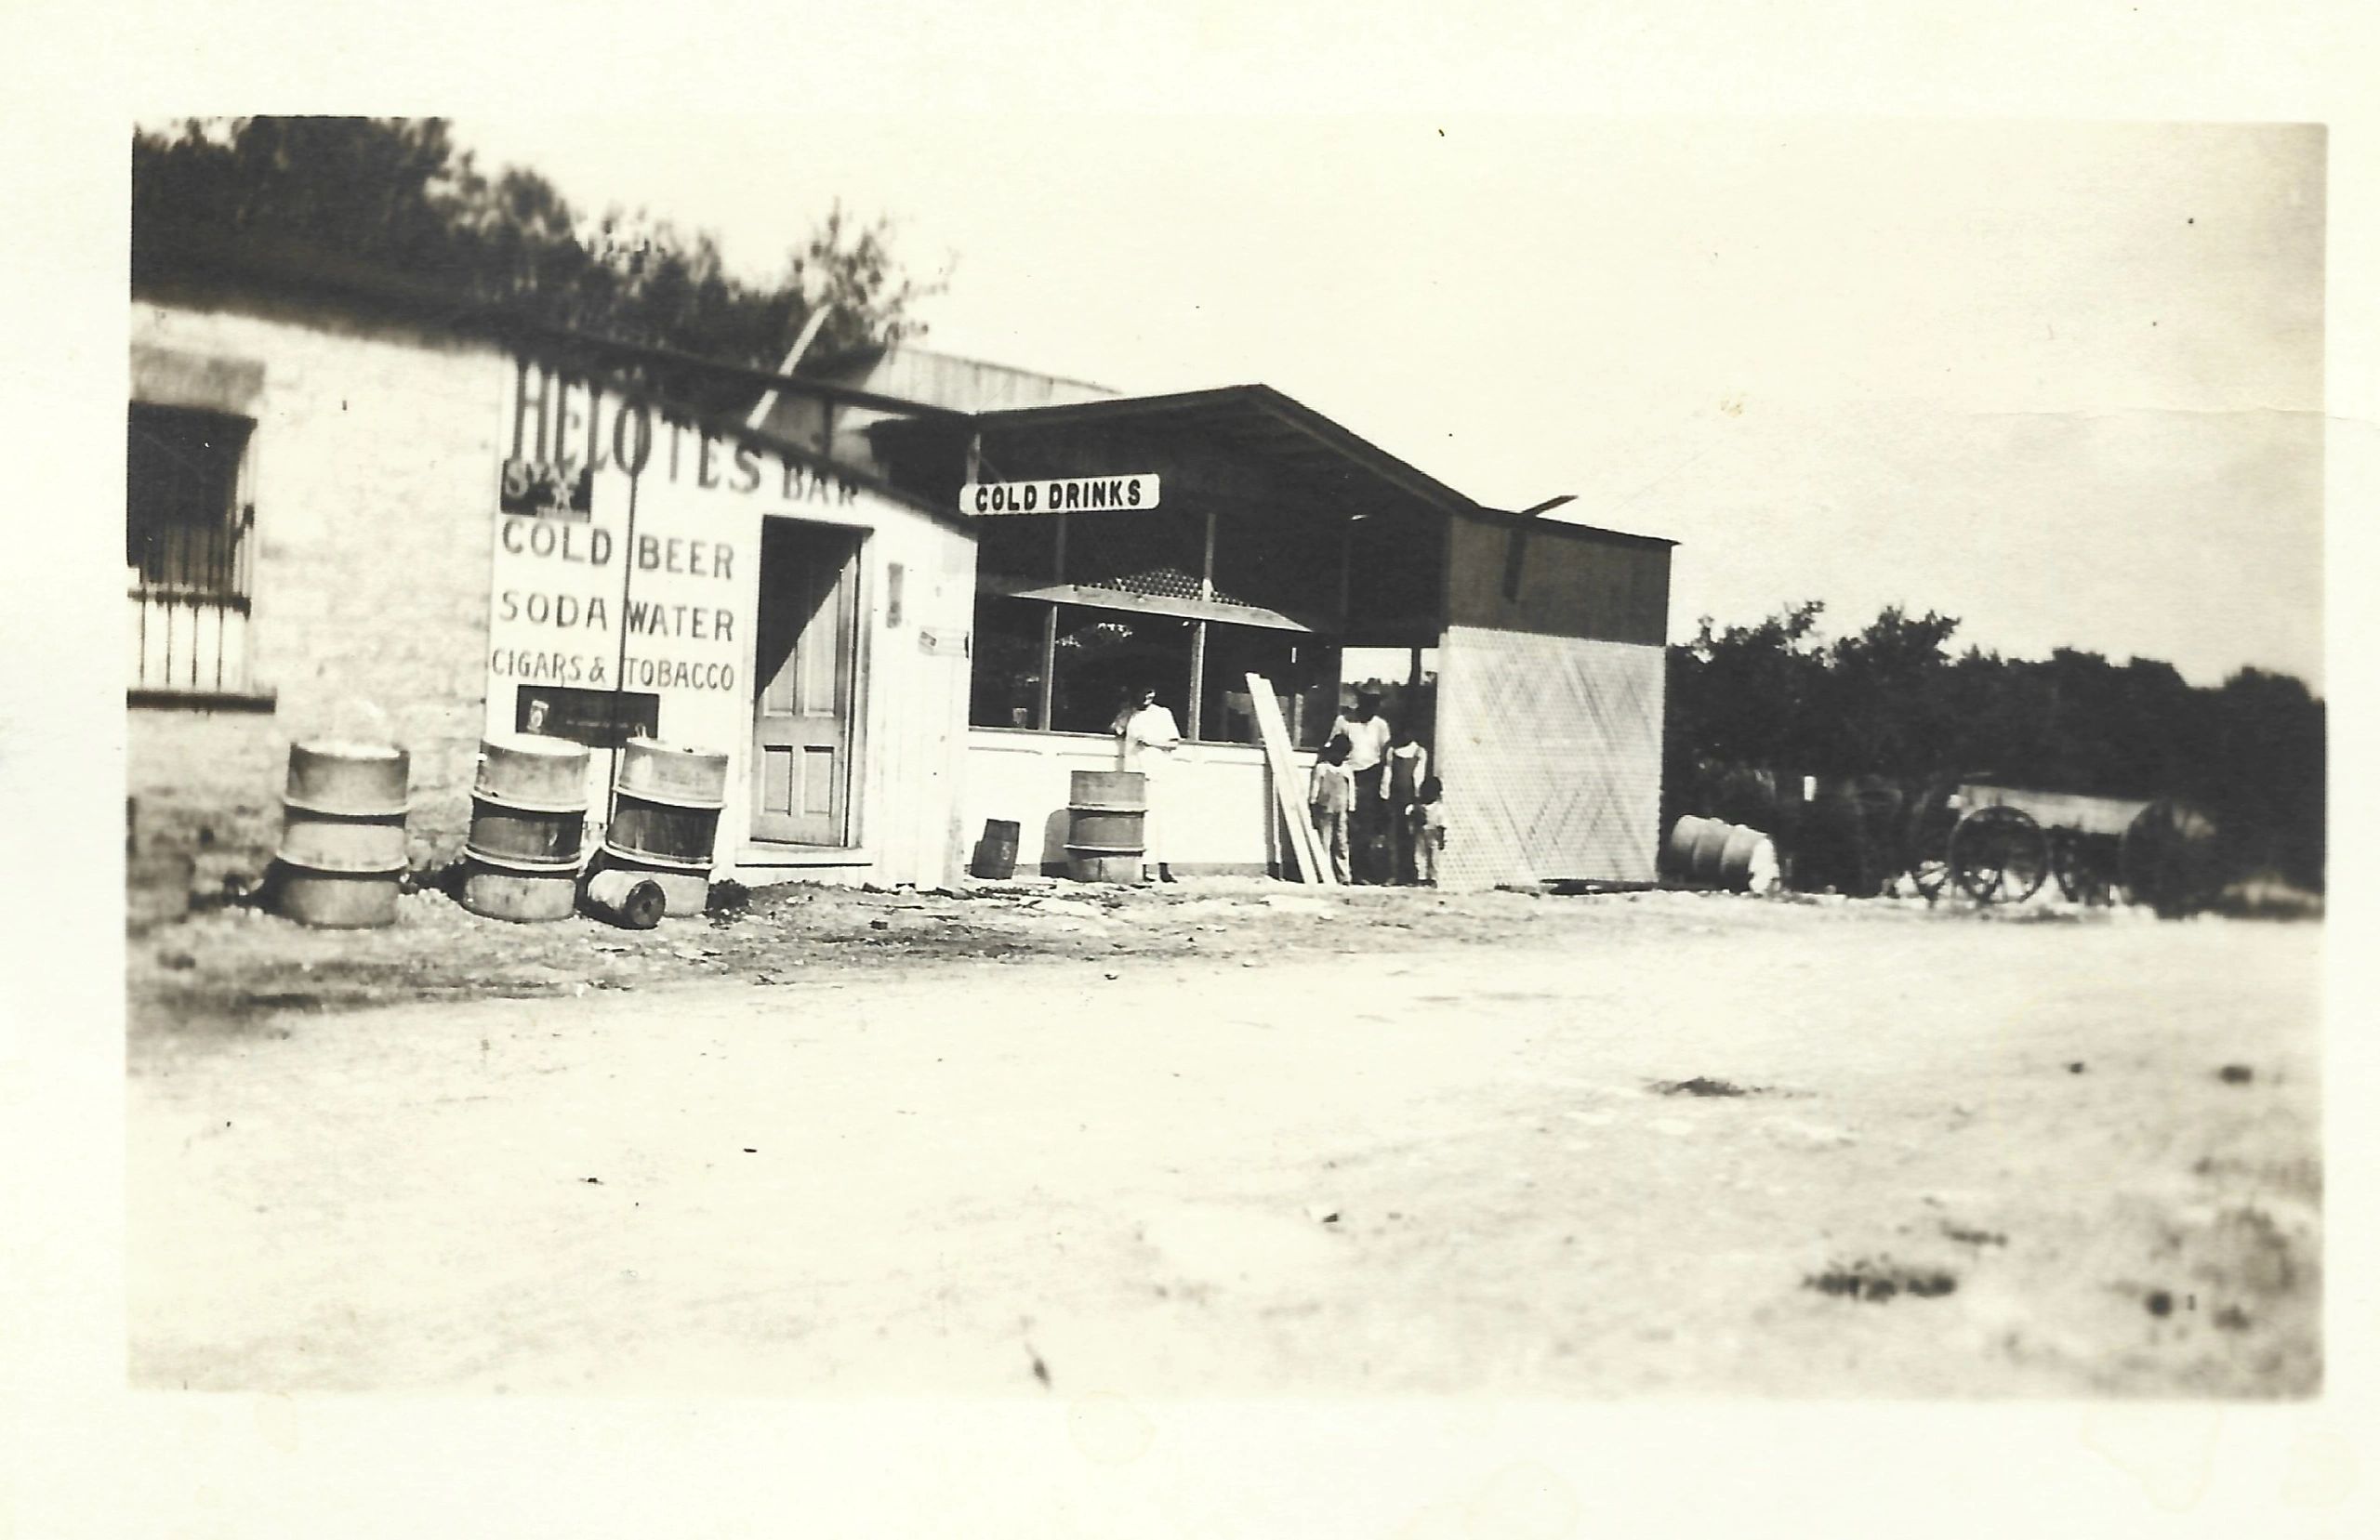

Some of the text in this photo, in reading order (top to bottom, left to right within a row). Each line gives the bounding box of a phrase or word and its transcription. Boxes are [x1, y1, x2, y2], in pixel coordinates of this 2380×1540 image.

[513, 357, 760, 494] HELOTES
[974, 479, 1142, 512] COLD DRINKS
[501, 520, 734, 580] COLD BEER
[498, 590, 734, 641] SODA WATER
[491, 647, 734, 691] CIGARS & TOBACCO
